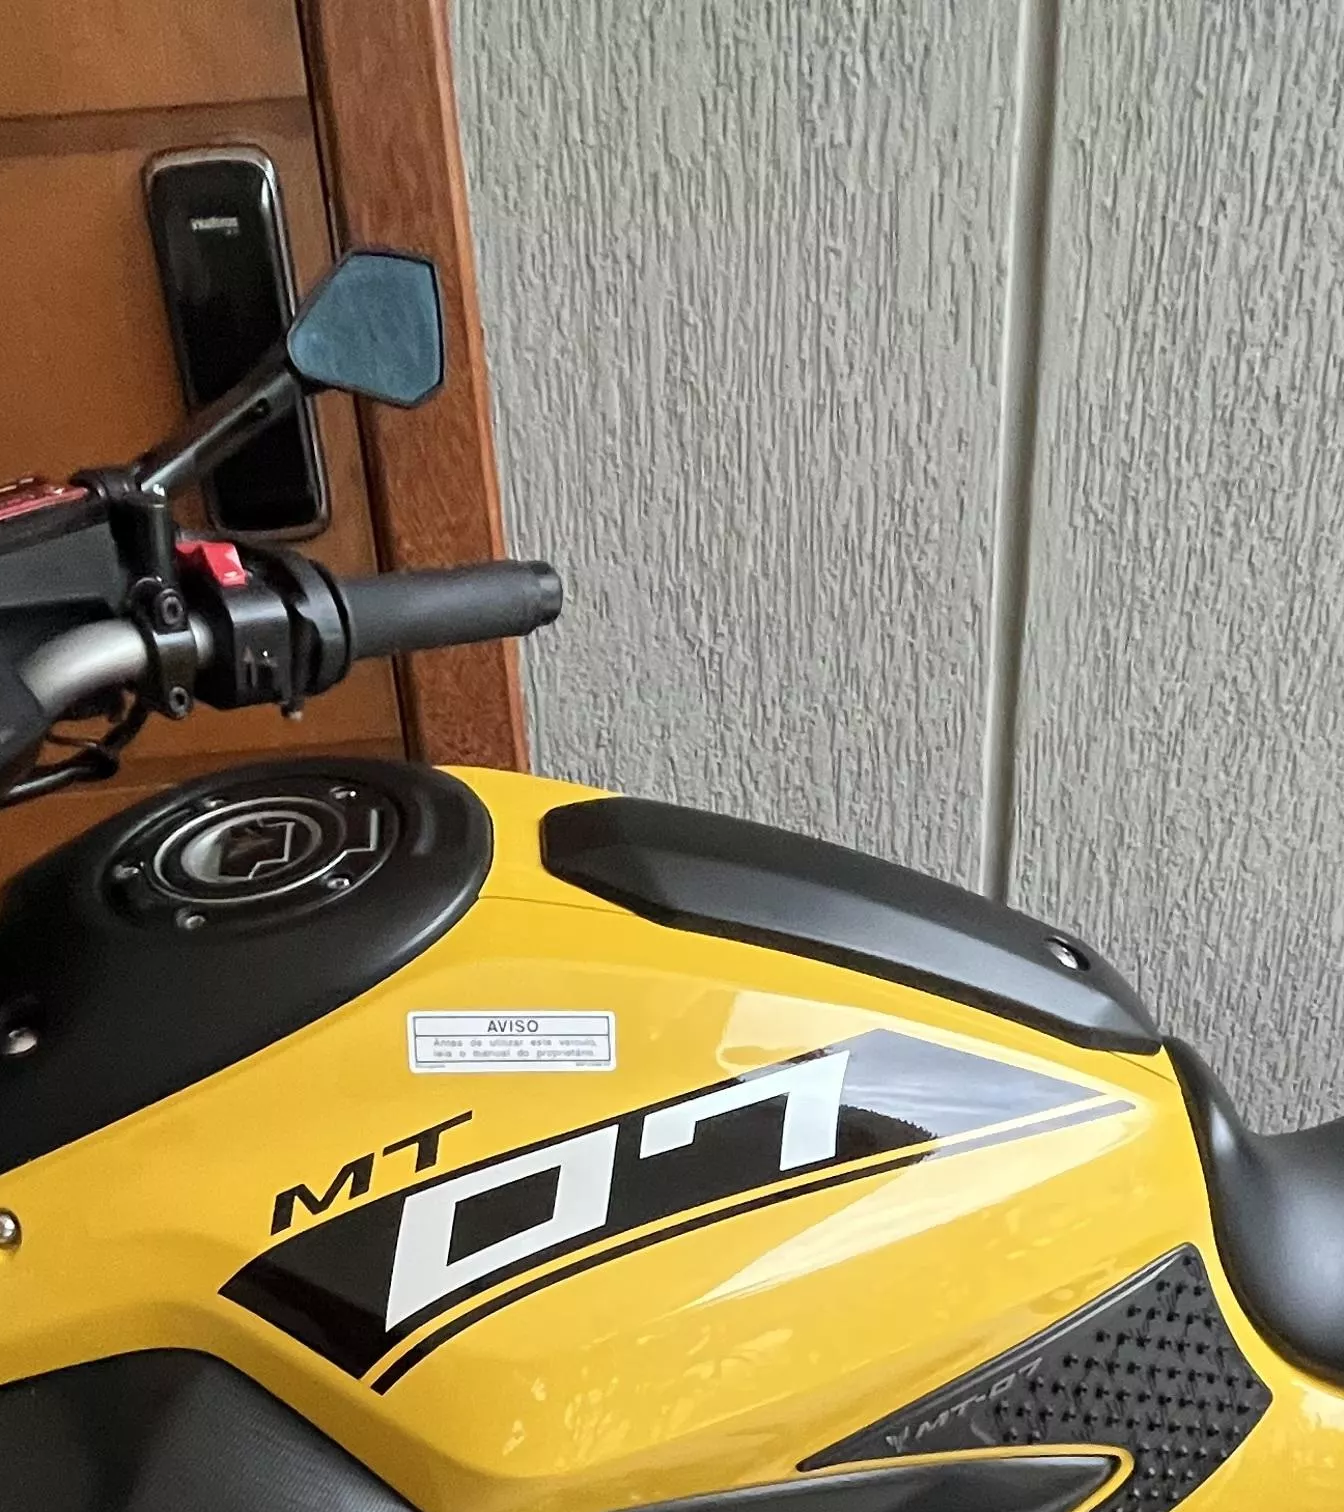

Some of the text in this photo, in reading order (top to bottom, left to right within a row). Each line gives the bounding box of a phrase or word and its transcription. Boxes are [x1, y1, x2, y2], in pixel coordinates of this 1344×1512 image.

[487, 1020, 539, 1033] AVISO
[270, 1110, 473, 1237] MT
[386, 1050, 851, 1332] 07
[914, 1356, 1044, 1441] MT-07
